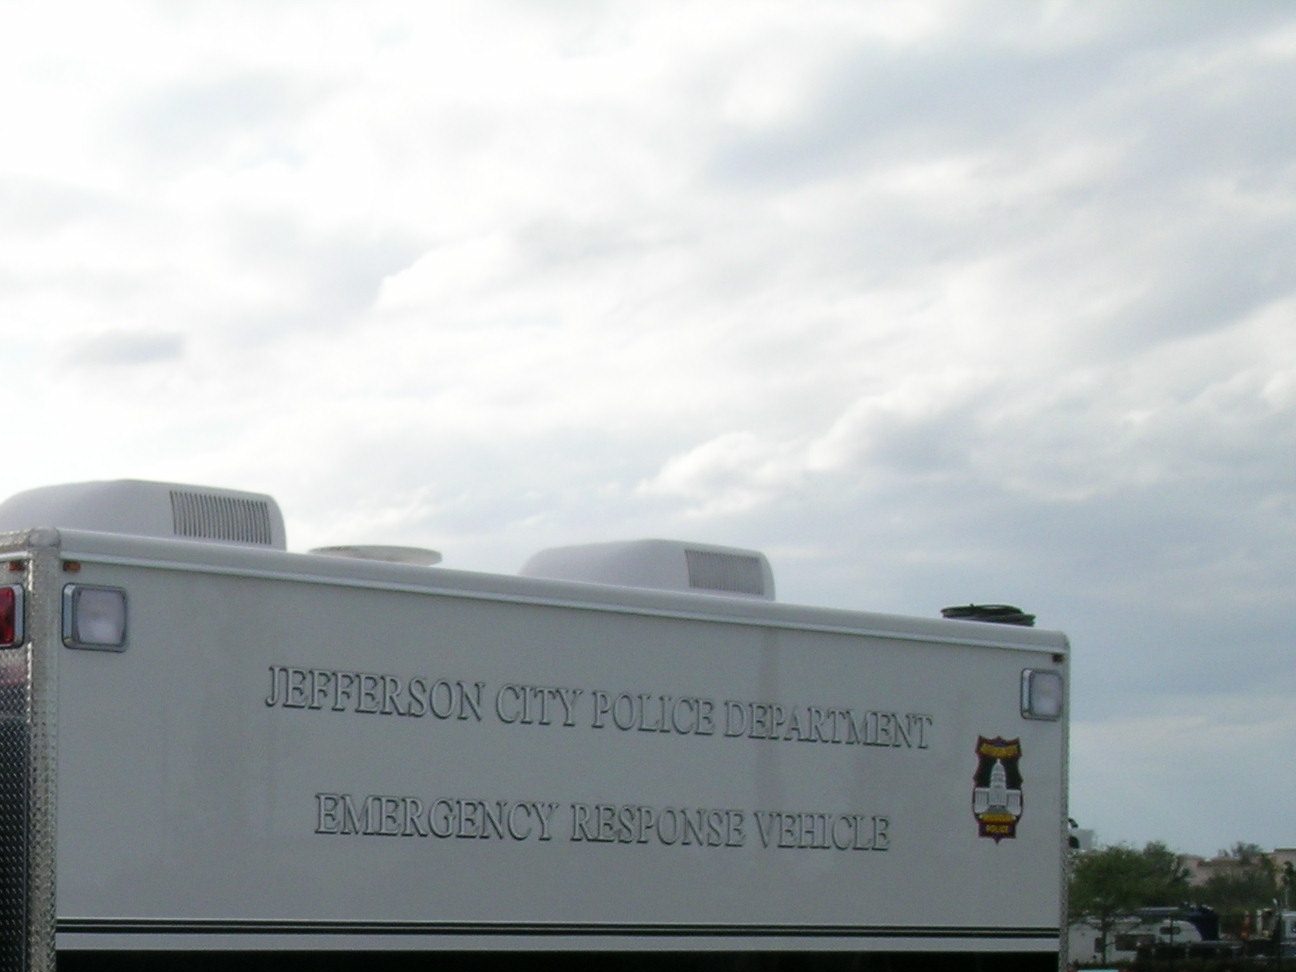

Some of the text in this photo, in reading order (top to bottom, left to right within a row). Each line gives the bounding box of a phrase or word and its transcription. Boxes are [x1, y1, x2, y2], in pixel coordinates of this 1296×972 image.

[265, 665, 933, 750] JEFFERSON CITY POLICE DEPARTMENT
[314, 792, 891, 851] EMERGENCY RESPONSE VEHICLE
